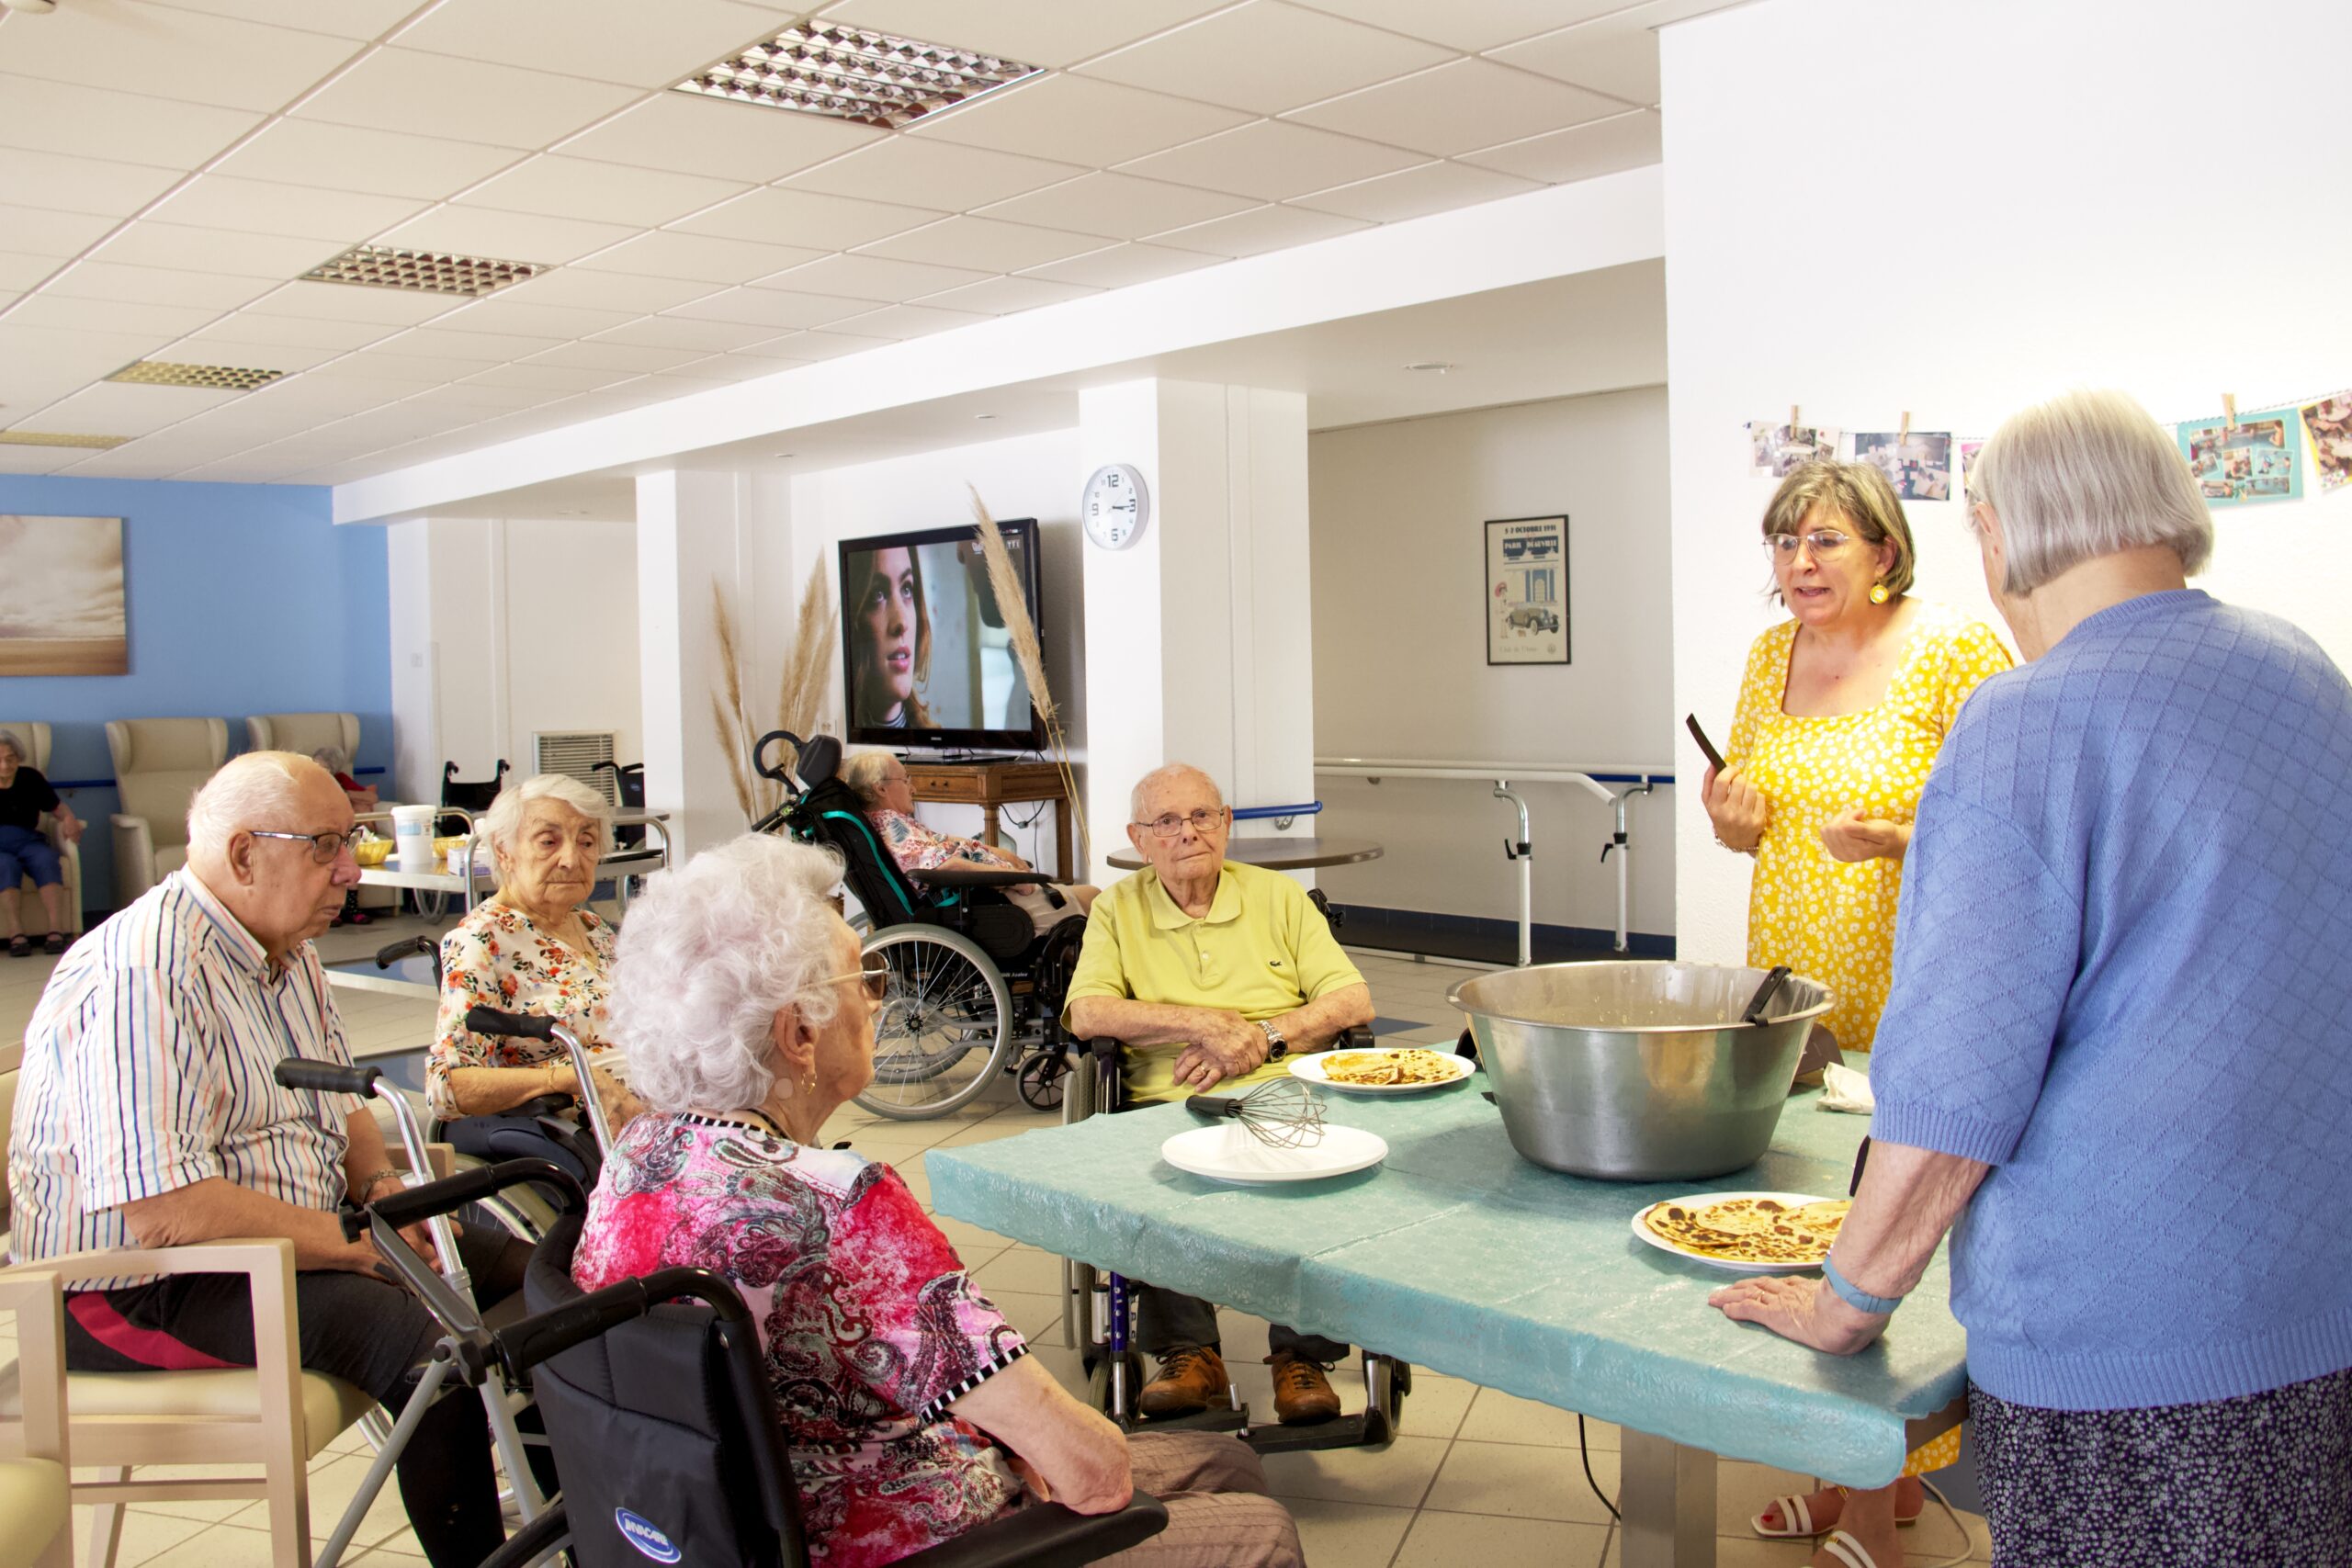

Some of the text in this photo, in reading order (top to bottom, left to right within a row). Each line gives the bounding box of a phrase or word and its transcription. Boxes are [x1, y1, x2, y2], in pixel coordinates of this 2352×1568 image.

[1107, 474, 1119, 488] 12
[1091, 502, 1099, 516] 9
[1129, 499, 1136, 513] 3
[1112, 528, 1118, 542] 6
[625, 1517, 669, 1547] INVACARE
